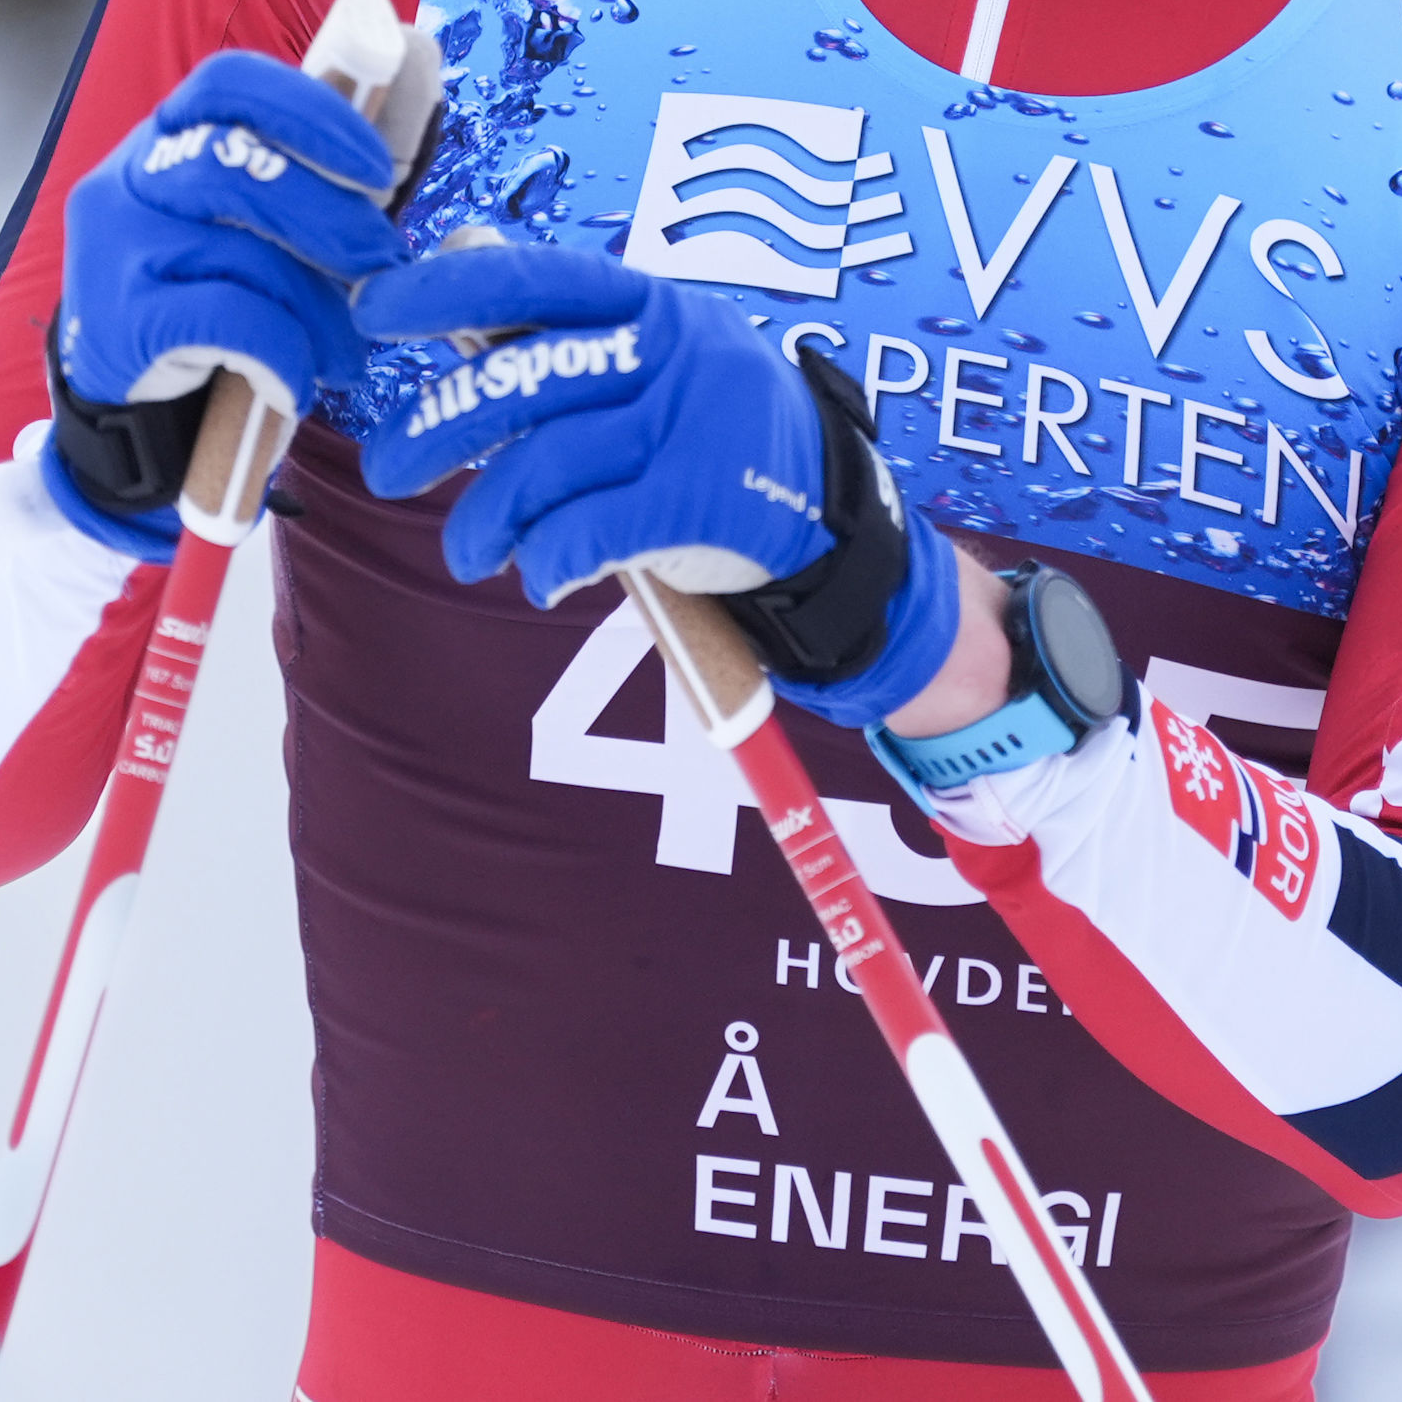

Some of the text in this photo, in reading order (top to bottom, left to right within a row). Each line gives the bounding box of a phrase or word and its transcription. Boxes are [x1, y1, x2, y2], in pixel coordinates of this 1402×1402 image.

[921, 125, 1352, 399] VVS
[748, 314, 1363, 548] PERTEN
[117, 759, 169, 785] CARBO
[776, 938, 1073, 1017] HVDE
[695, 1020, 780, 1137] Å
